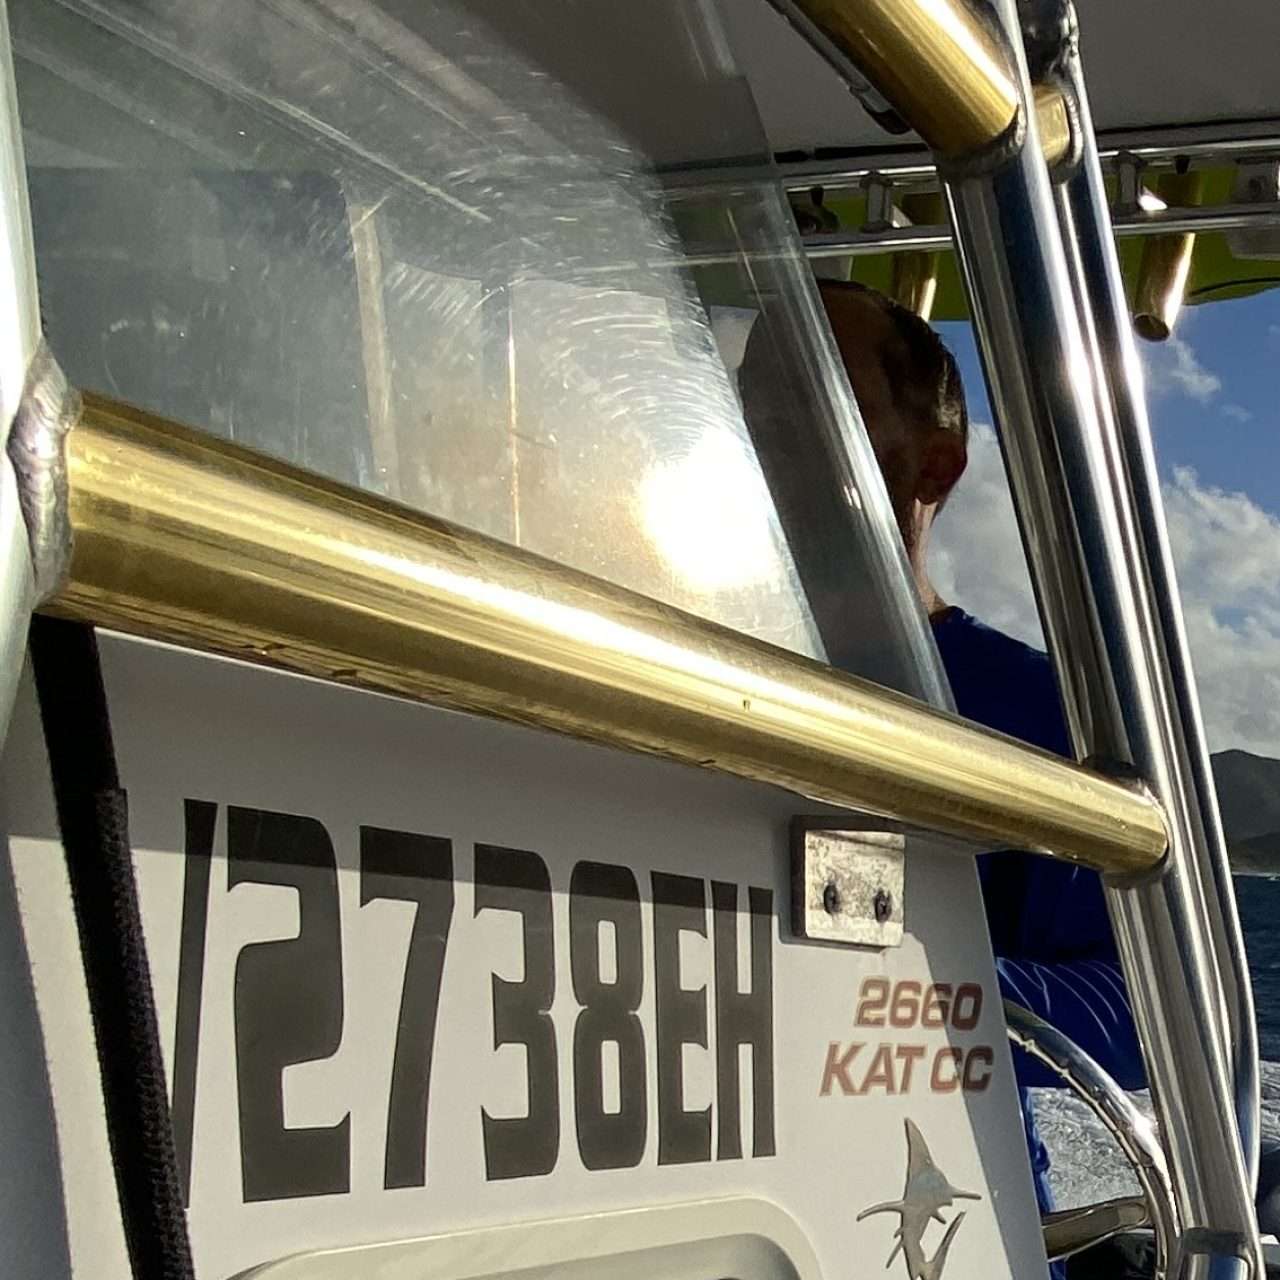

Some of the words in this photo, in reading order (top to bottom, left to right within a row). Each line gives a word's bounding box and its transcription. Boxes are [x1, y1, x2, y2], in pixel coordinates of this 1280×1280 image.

[855, 977, 984, 1031] 2660
[820, 1041, 927, 1096] KAT
[929, 1044, 995, 1094] CC
